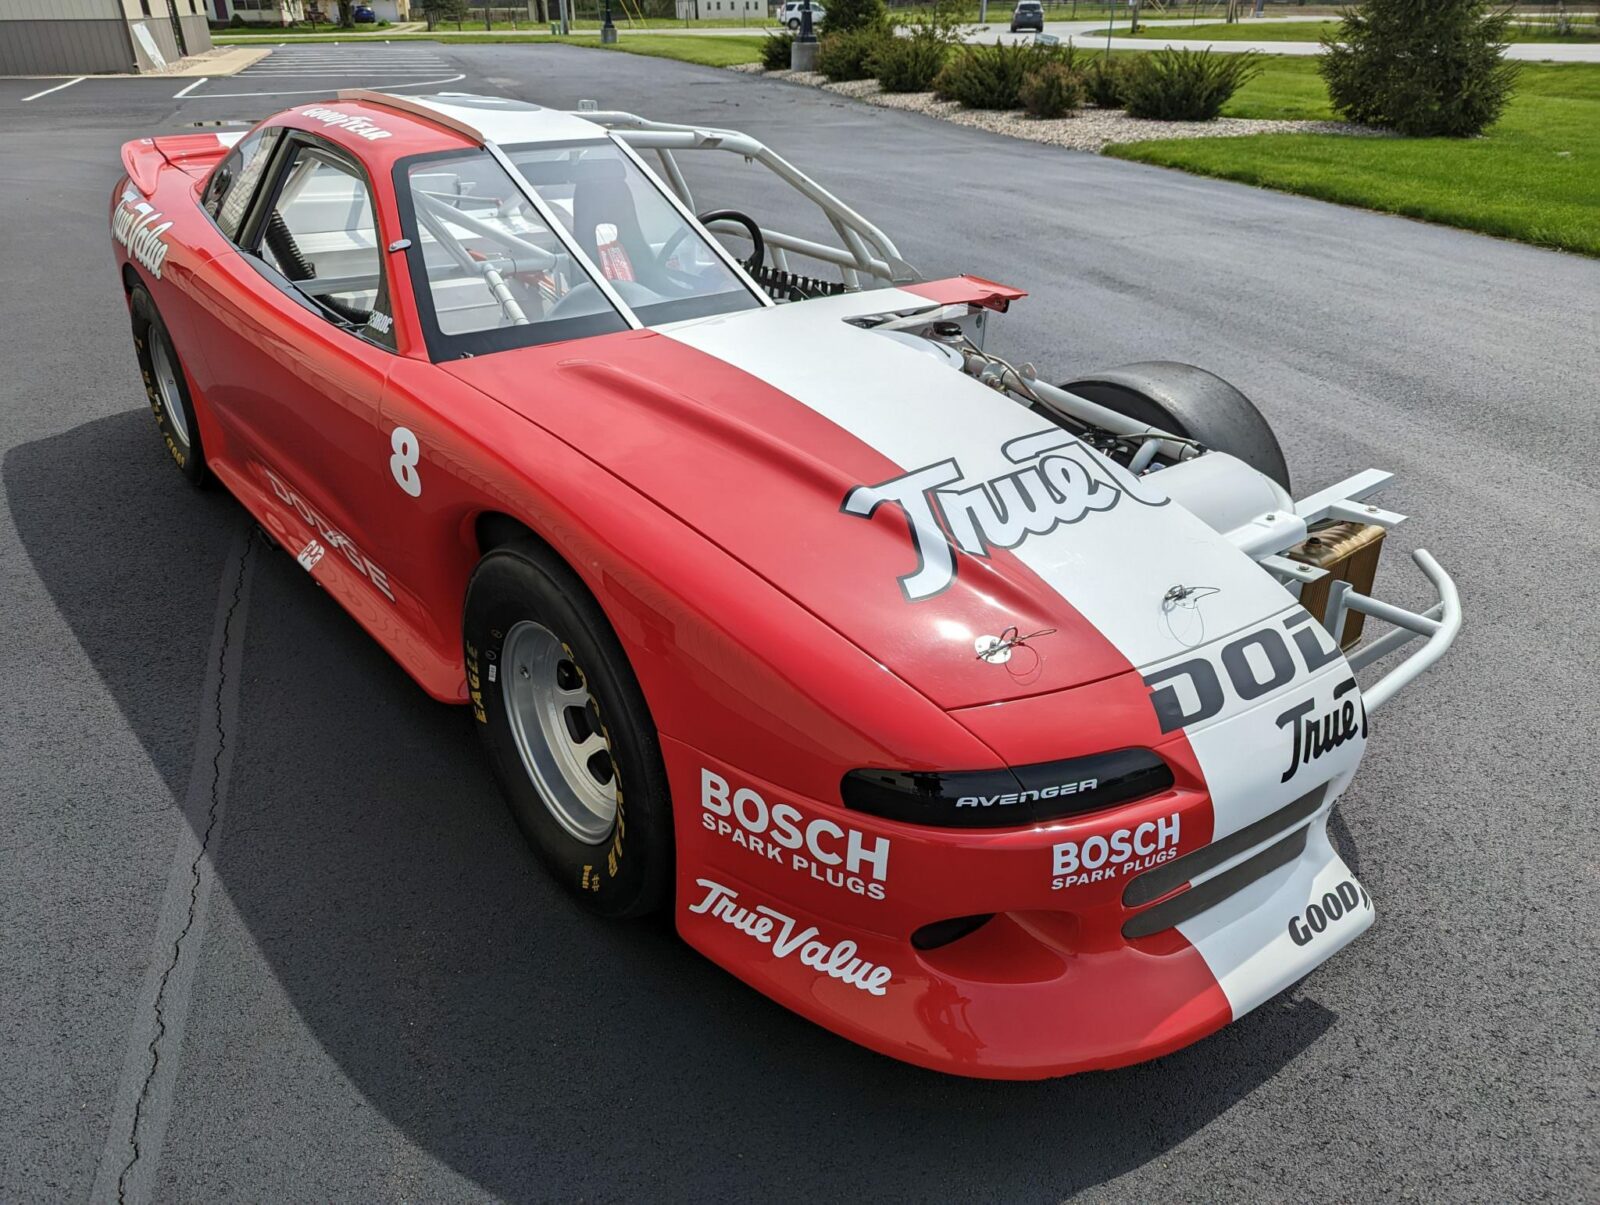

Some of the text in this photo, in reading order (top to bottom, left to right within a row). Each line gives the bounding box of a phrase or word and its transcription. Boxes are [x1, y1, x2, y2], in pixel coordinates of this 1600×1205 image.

[389, 426, 422, 498] 8
[265, 469, 396, 602] DODGE
[466, 642, 488, 724] EAGLE
[701, 767, 891, 882] BOSCH
[955, 778, 1098, 808] AVENGER
[702, 812, 887, 901] SPARK PLUGS
[1051, 847, 1178, 890] SPARK PLUGS
[1052, 812, 1180, 877] BOSCH
